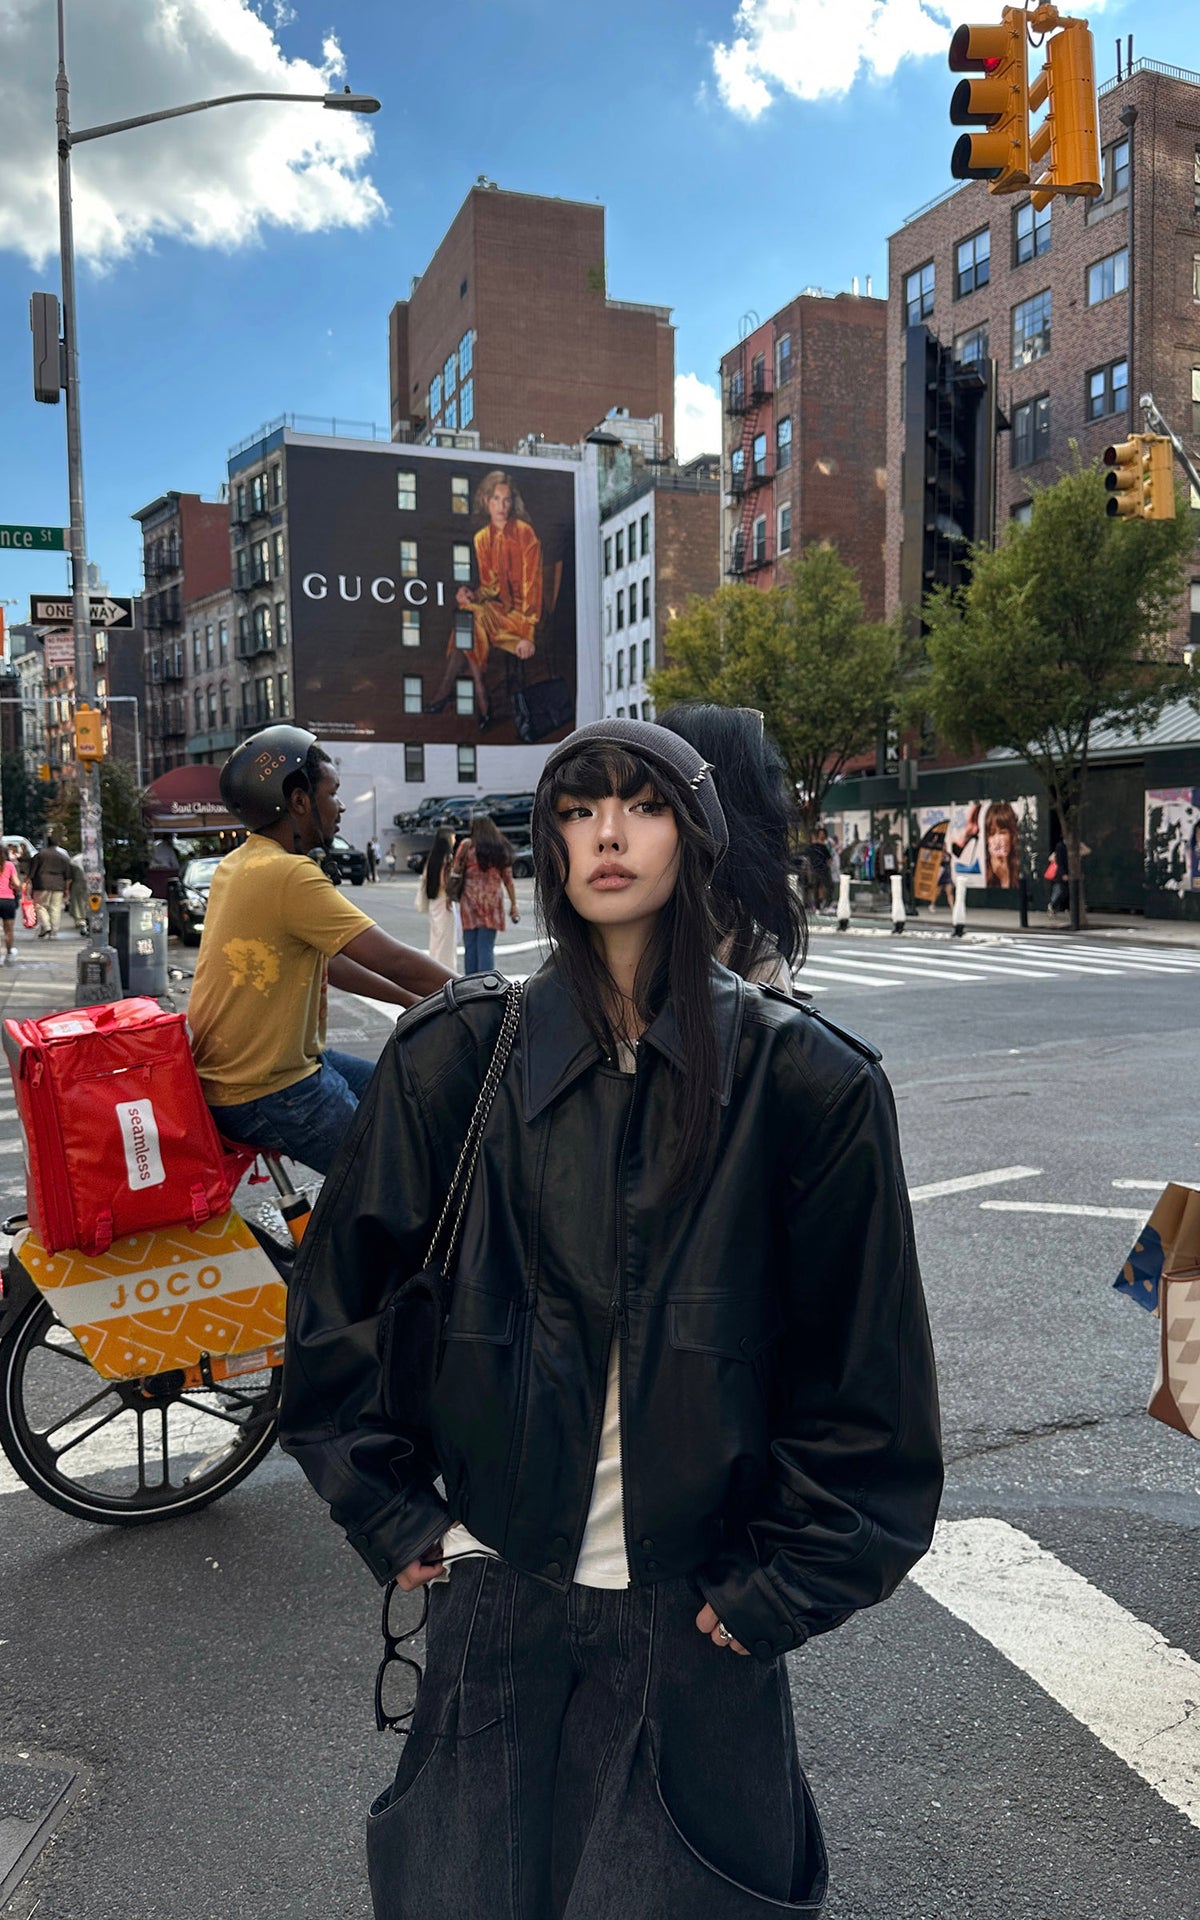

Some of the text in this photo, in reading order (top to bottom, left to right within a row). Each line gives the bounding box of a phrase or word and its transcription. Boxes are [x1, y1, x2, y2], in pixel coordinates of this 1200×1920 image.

[41, 529, 52, 542] St
[302, 572, 444, 606] GUCCI
[45, 604, 117, 619] ONE WAY
[259, 755, 286, 781] JOCO
[128, 1108, 151, 1181] seamless
[110, 1265, 222, 1309] JOCO
